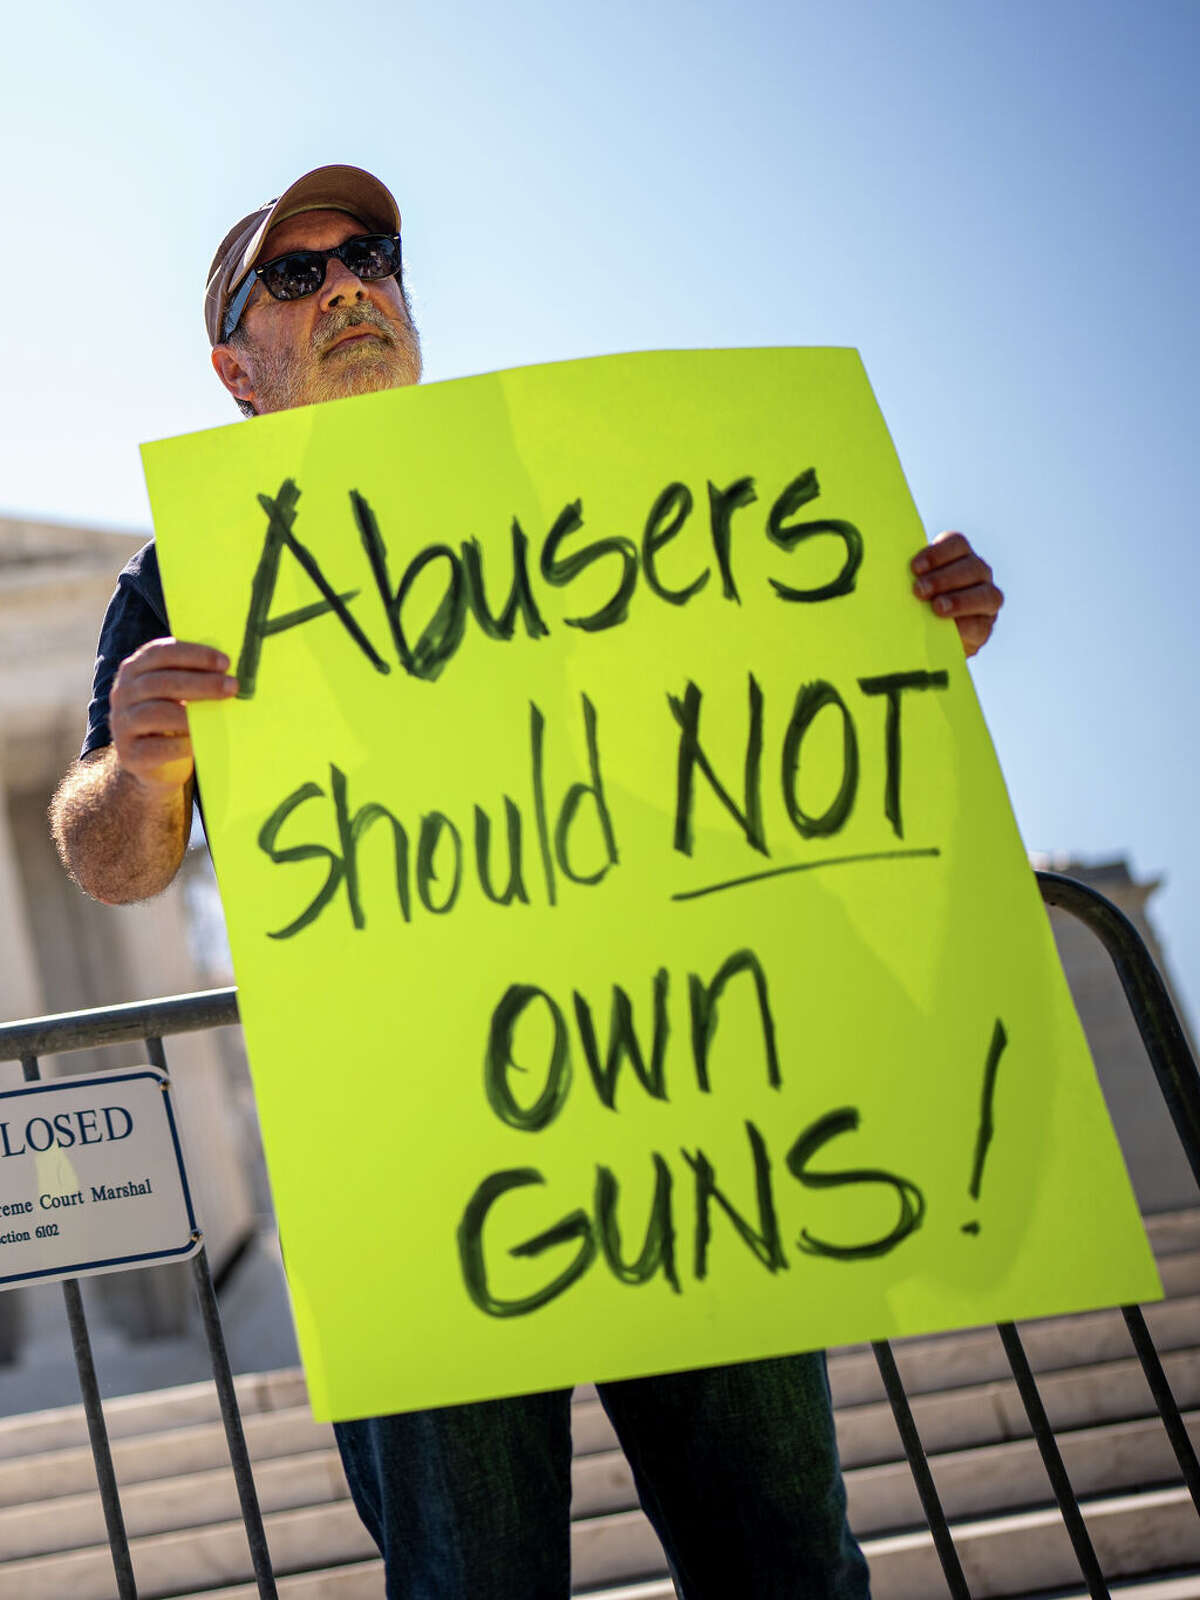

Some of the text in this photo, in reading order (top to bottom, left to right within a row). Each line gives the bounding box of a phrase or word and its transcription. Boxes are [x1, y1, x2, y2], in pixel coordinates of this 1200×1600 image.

[236, 466, 865, 701] Abusers
[666, 669, 950, 859] NOT
[35, 1223, 60, 1240] 6102
[39, 1190, 86, 1211] Court
[90, 1178, 153, 1203] Marshal
